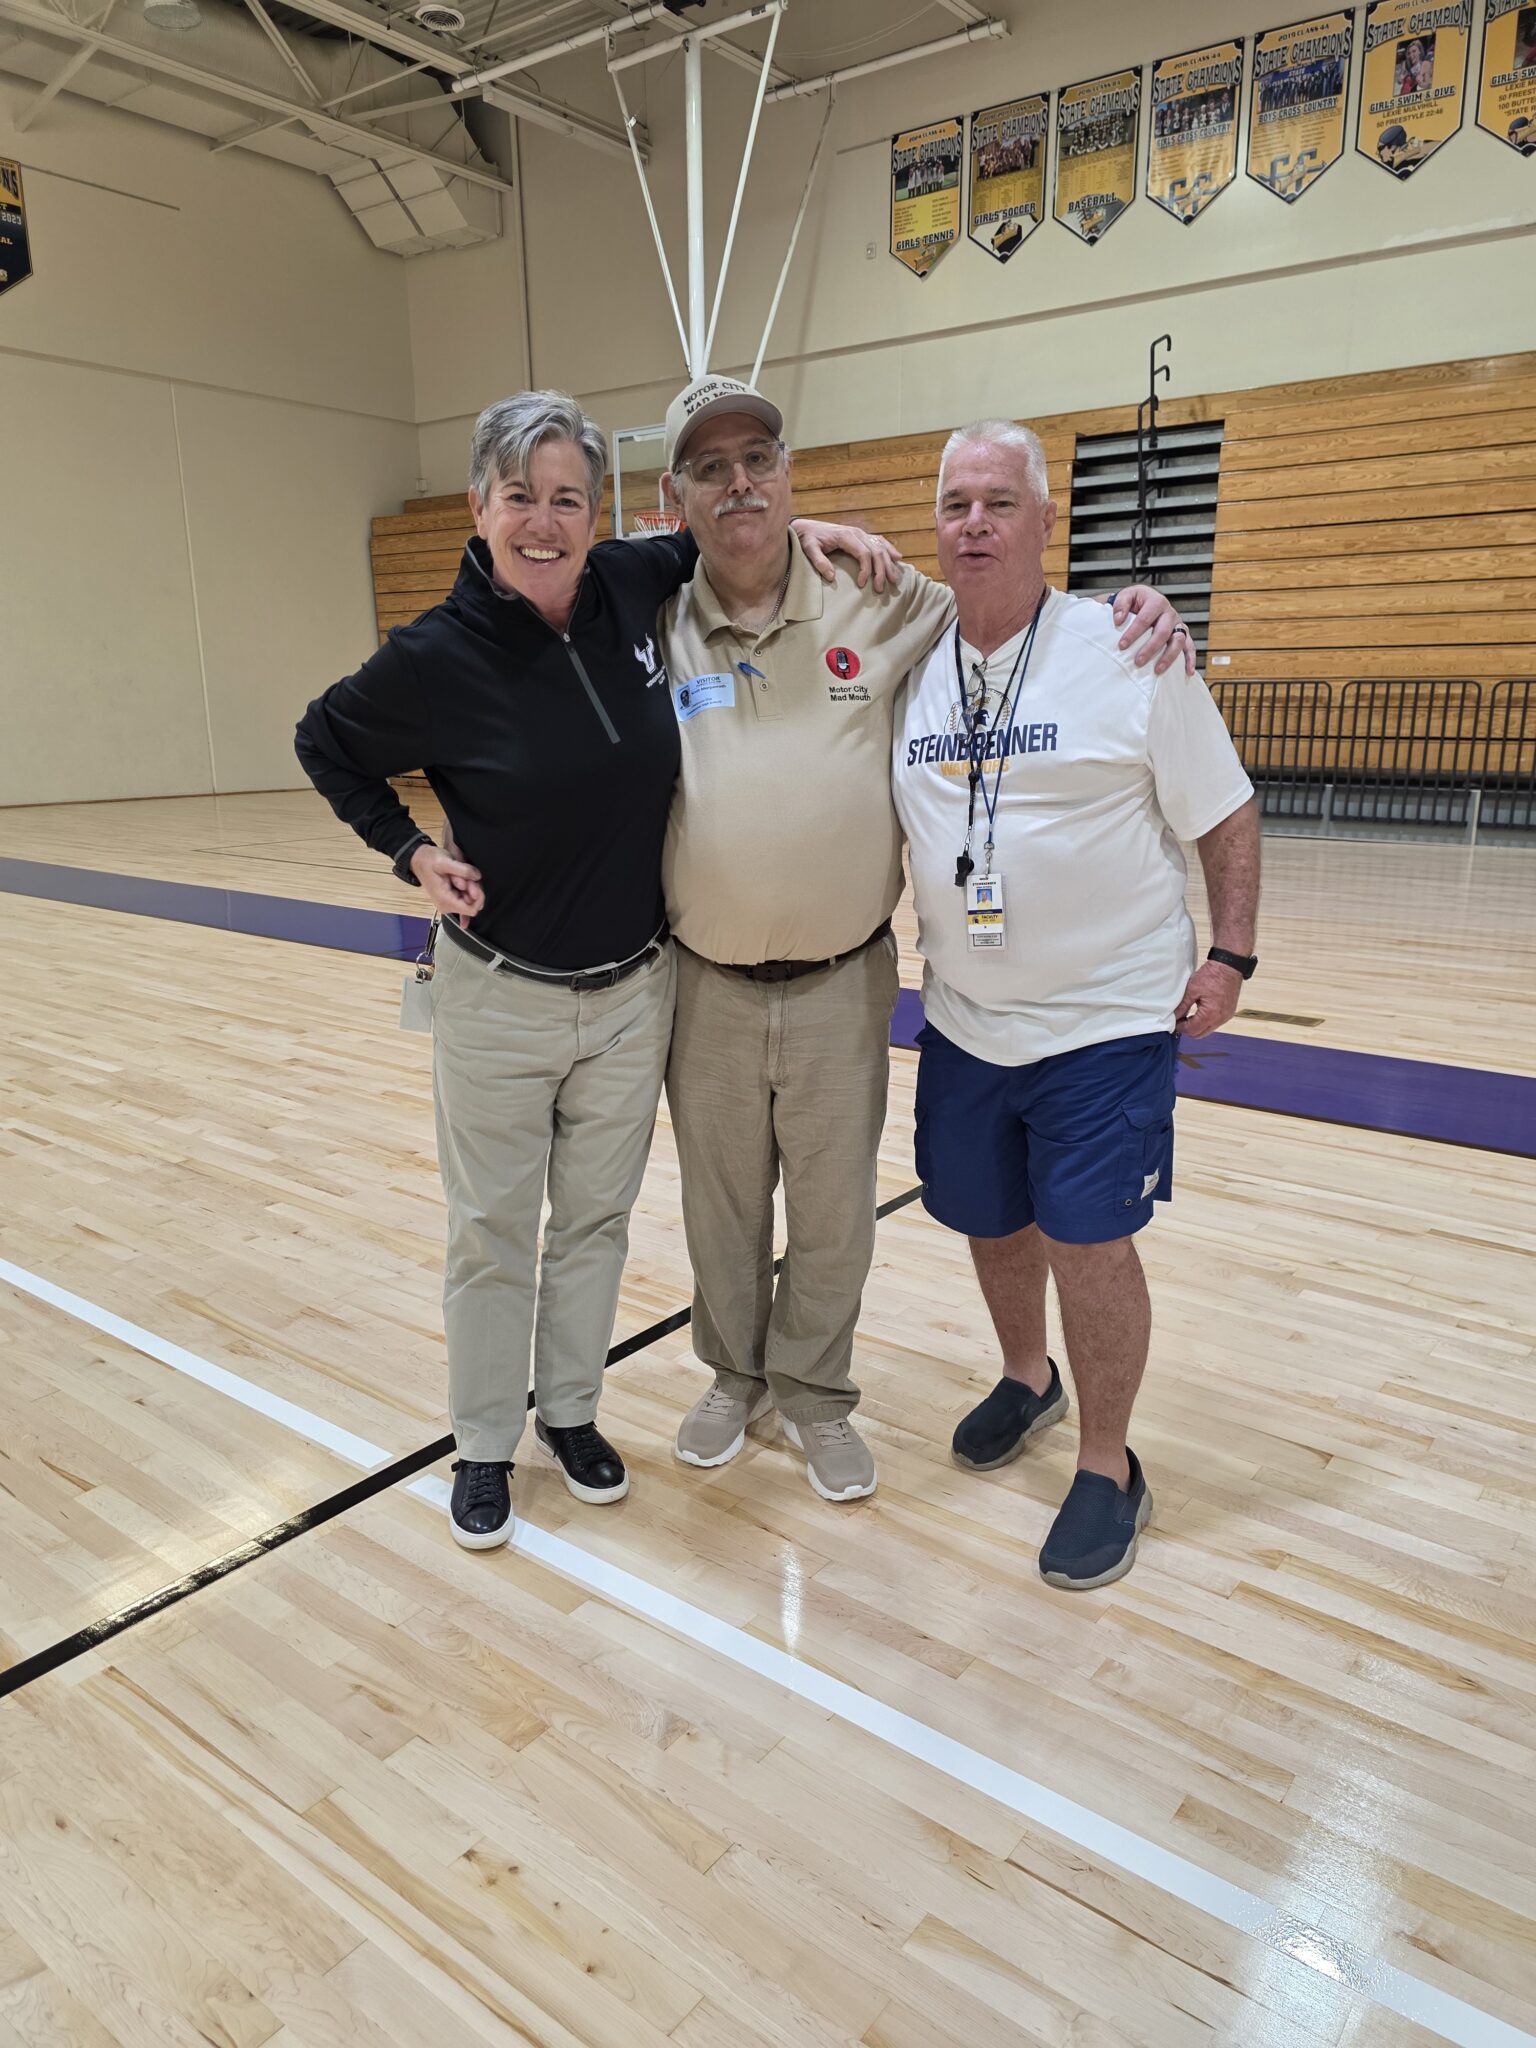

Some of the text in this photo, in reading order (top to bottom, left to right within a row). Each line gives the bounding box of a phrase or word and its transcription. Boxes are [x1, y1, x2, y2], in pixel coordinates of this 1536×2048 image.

[1486, 0, 1529, 20] STA
[1367, 0, 1470, 49] STATE CHAMPION
[1255, 26, 1351, 78] STATE CHAMPIONS
[1152, 54, 1241, 104] STATE CHAMPIONS
[1491, 71, 1518, 86] GIRLS
[1059, 82, 1139, 128] STATE CHAMPIONS
[1258, 97, 1338, 124] BOYS CROSS COUNTRY
[1370, 85, 1456, 113] GIRLS SWIM & DIVE
[972, 107, 1047, 151] STATE CHAMPIONS
[1385, 112, 1424, 126] FREESTYLE
[1157, 122, 1232, 148] GIRLS CROSS COUNTRY
[893, 130, 961, 173] STATE CHAMPIONS
[974, 210, 999, 225] GIRLS
[1002, 202, 1036, 218] SOCCER
[1068, 191, 1117, 211] BASEBALL
[896, 229, 954, 250] GIRLS TENNIS
[683, 382, 746, 407] MOTOR CITY
[696, 676, 721, 685] VISITOR
[853, 685, 868, 694] City
[849, 693, 871, 701] Mouth
[907, 723, 1058, 767] STEINBRENNER
[940, 758, 1009, 776] WARORS
